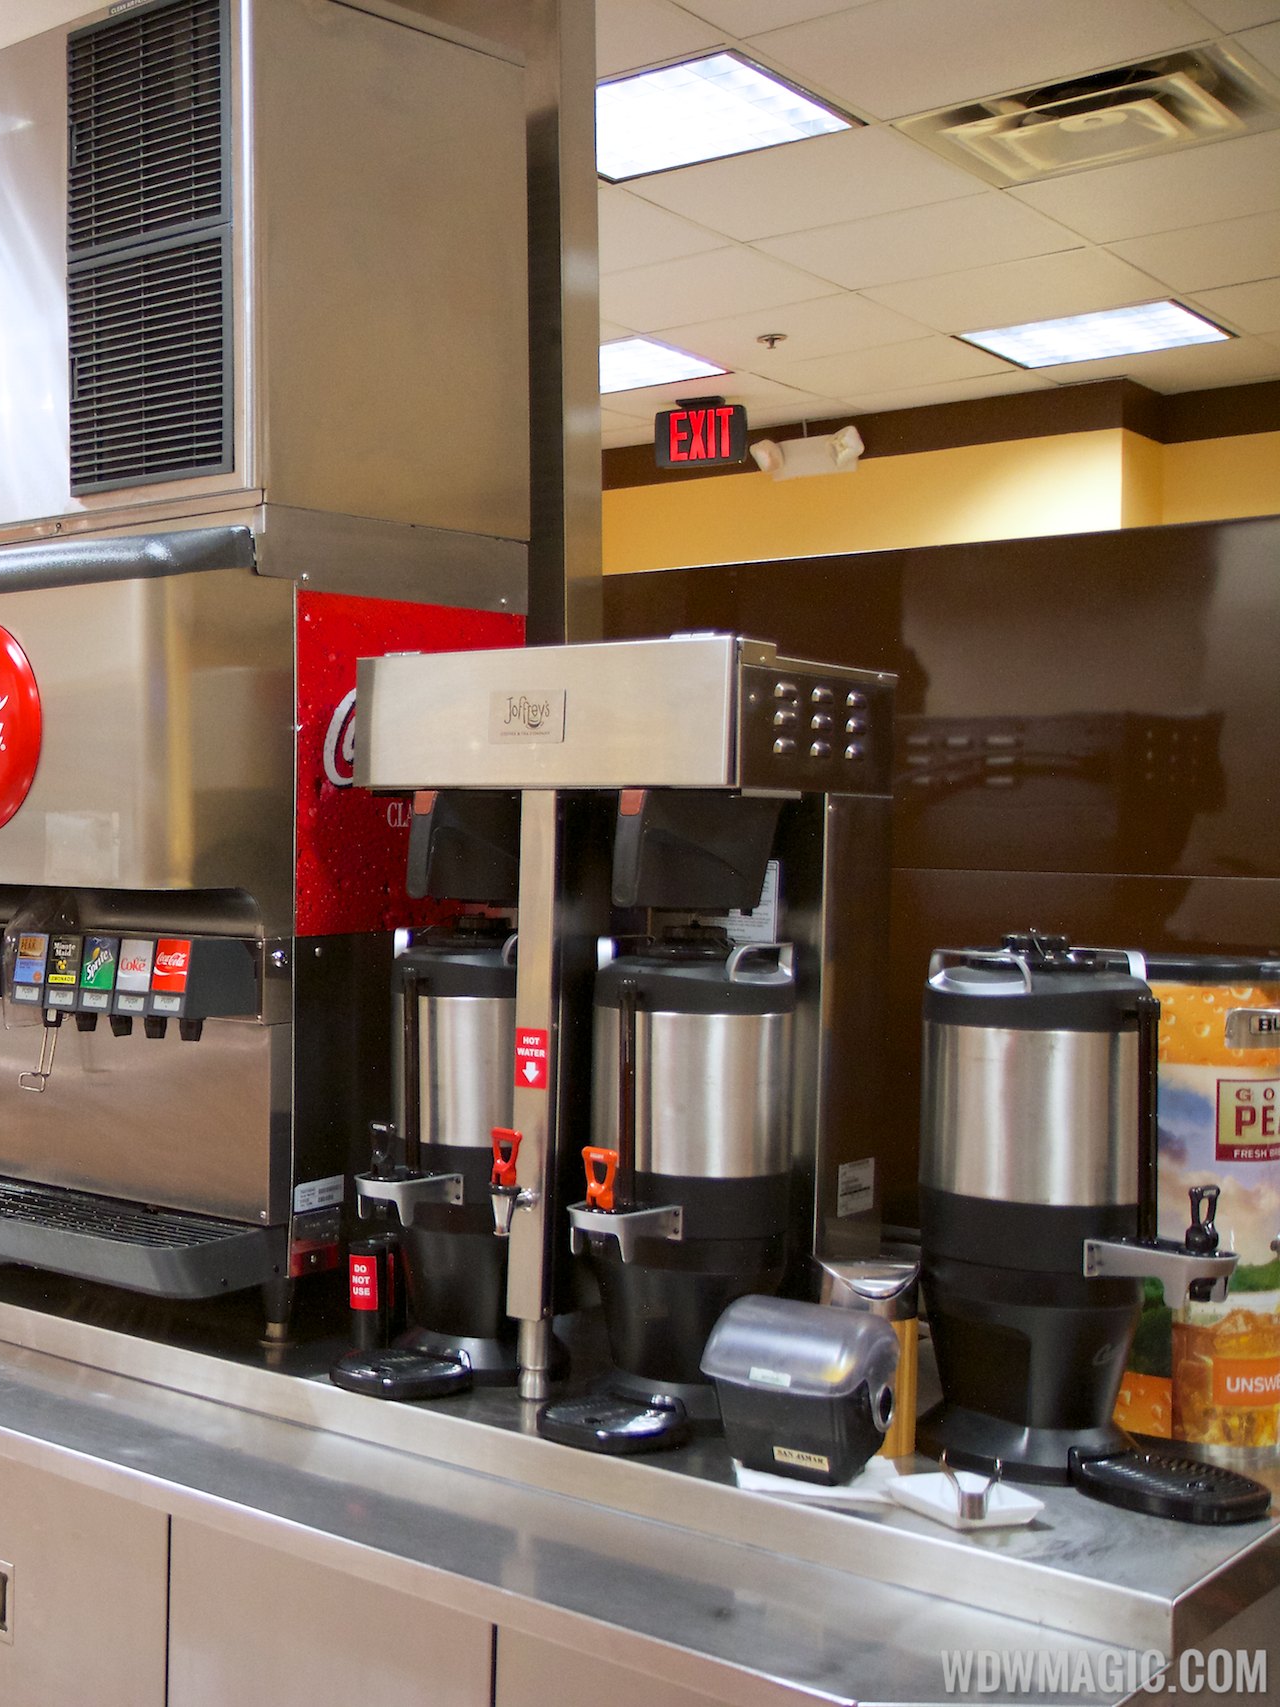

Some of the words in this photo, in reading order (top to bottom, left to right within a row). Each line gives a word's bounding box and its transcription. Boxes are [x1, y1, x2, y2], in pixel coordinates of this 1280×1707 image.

[670, 407, 734, 462] EXIT
[504, 696, 550, 726] Joffrey's
[86, 950, 109, 981] Sprite
[120, 958, 146, 972] Coke
[522, 1036, 540, 1045] HOT
[517, 1048, 545, 1058] WATER
[1235, 1105, 1280, 1136] PE
[1234, 1149, 1267, 1158] FRESH
[353, 1264, 367, 1273] DO
[352, 1275, 370, 1285] NOT
[352, 1286, 370, 1296] USE
